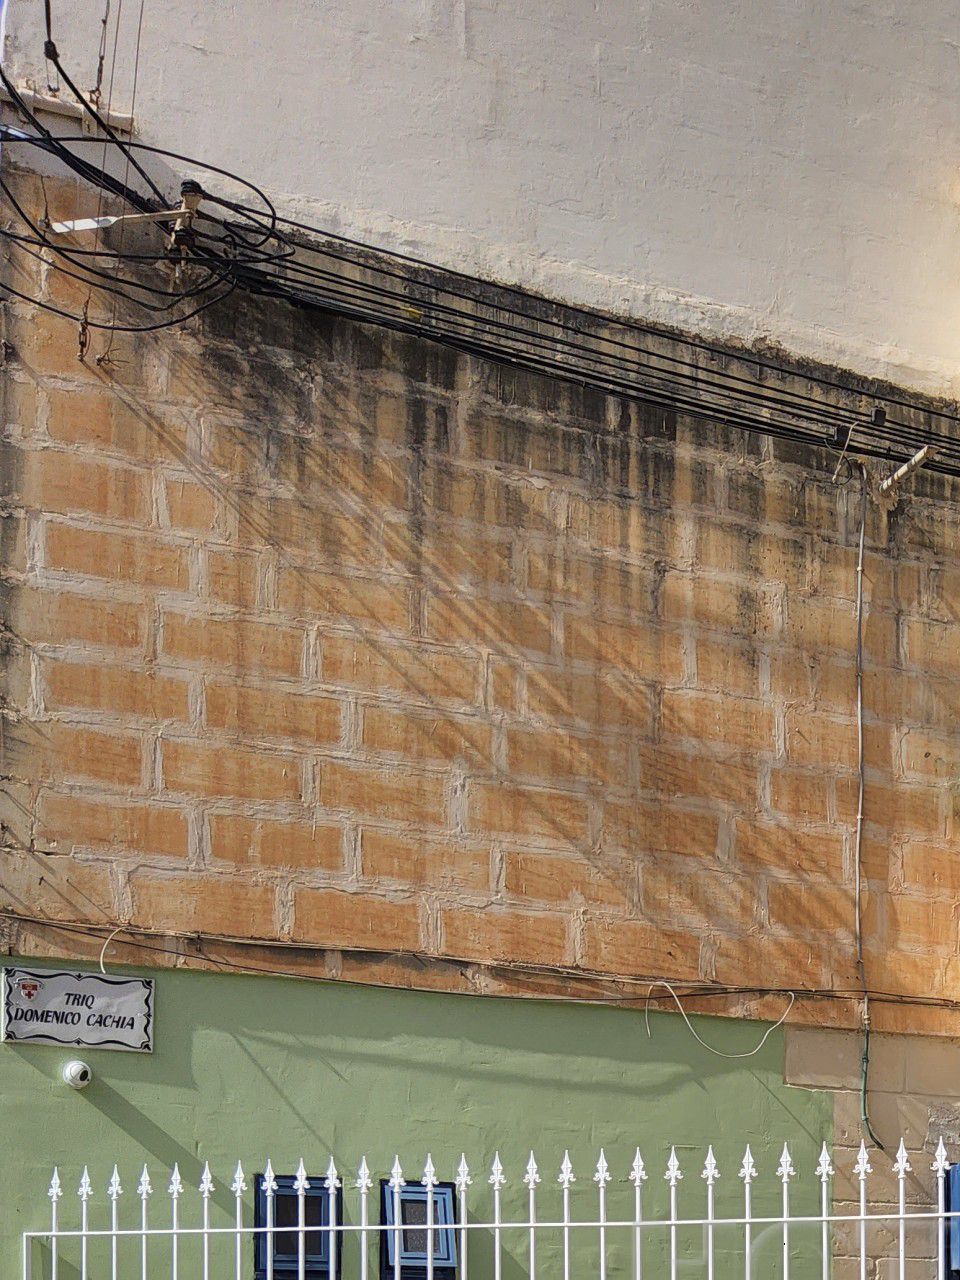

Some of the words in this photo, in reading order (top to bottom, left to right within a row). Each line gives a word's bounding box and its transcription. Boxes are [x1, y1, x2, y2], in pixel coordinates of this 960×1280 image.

[64, 993, 95, 1010] TRIQ
[13, 1008, 81, 1025] DOMENICO
[86, 1013, 135, 1030] CACHIA
